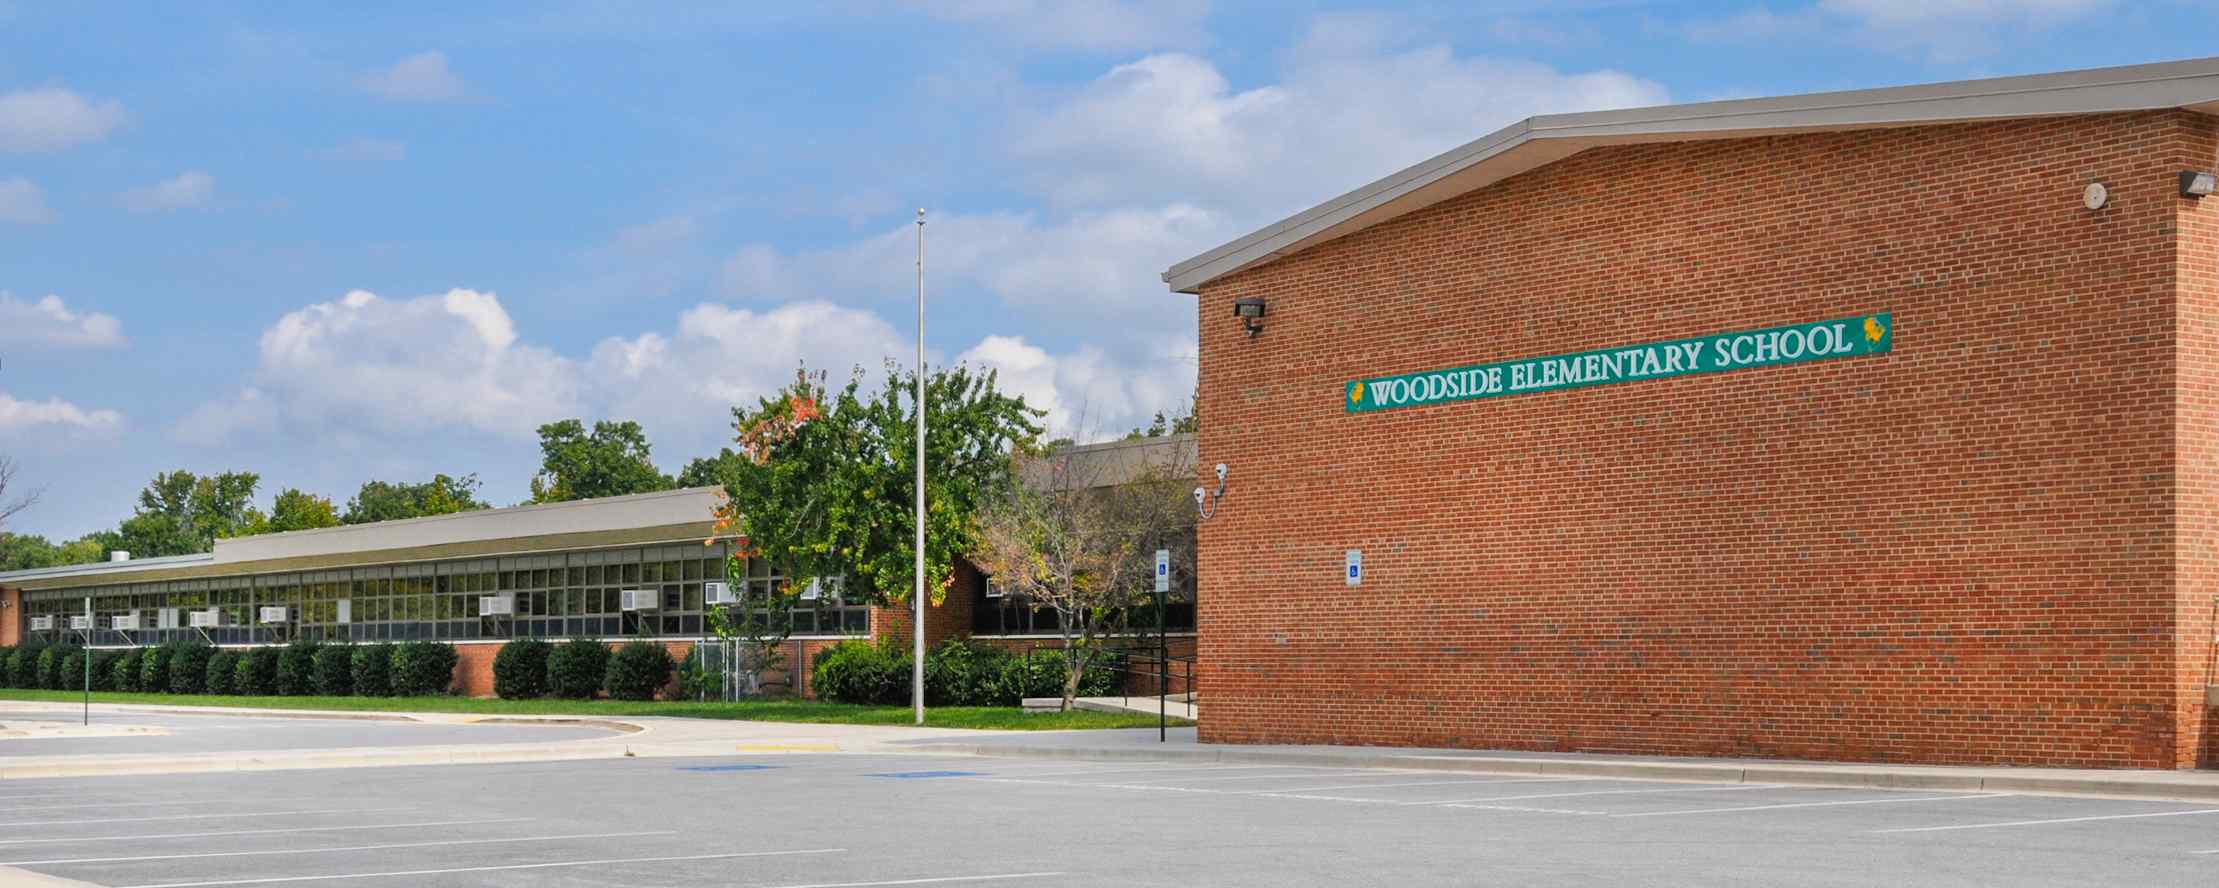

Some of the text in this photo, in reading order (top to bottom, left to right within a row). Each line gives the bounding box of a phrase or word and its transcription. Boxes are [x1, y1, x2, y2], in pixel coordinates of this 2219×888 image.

[1369, 323, 1853, 406] WOODSIDE ELEMENTARY SCHOOL
